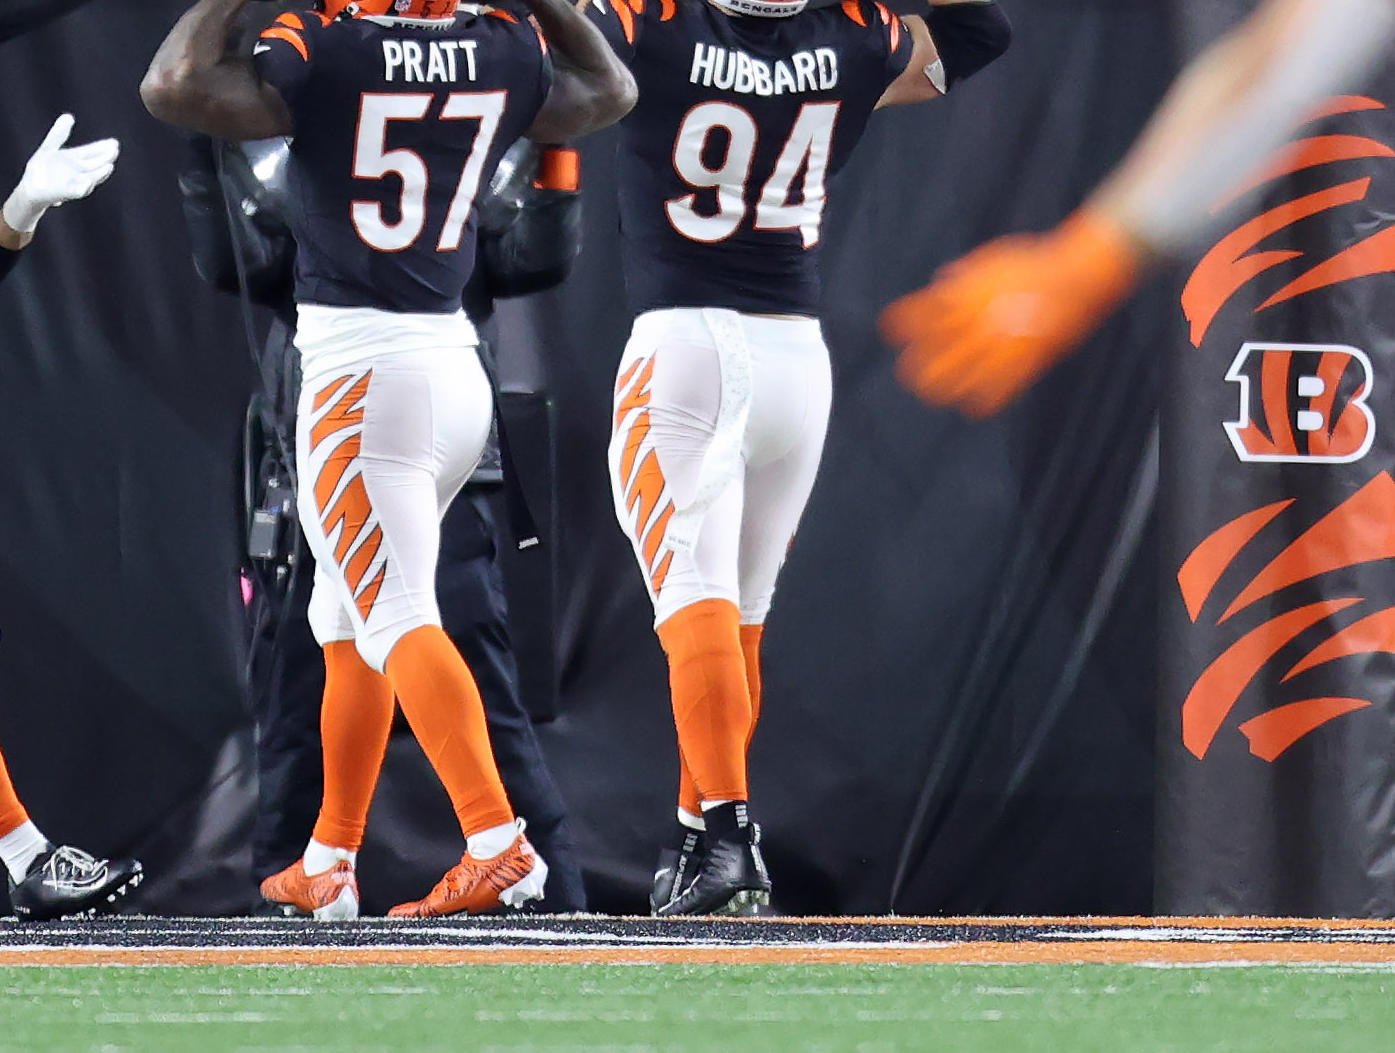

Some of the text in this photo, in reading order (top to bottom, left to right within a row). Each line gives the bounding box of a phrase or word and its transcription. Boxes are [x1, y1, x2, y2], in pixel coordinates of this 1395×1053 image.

[384, 39, 477, 82] PRATT
[691, 43, 838, 96] HUBBARD
[351, 90, 508, 252] 57
[665, 100, 842, 249] 94
[1223, 342, 1376, 464] B
